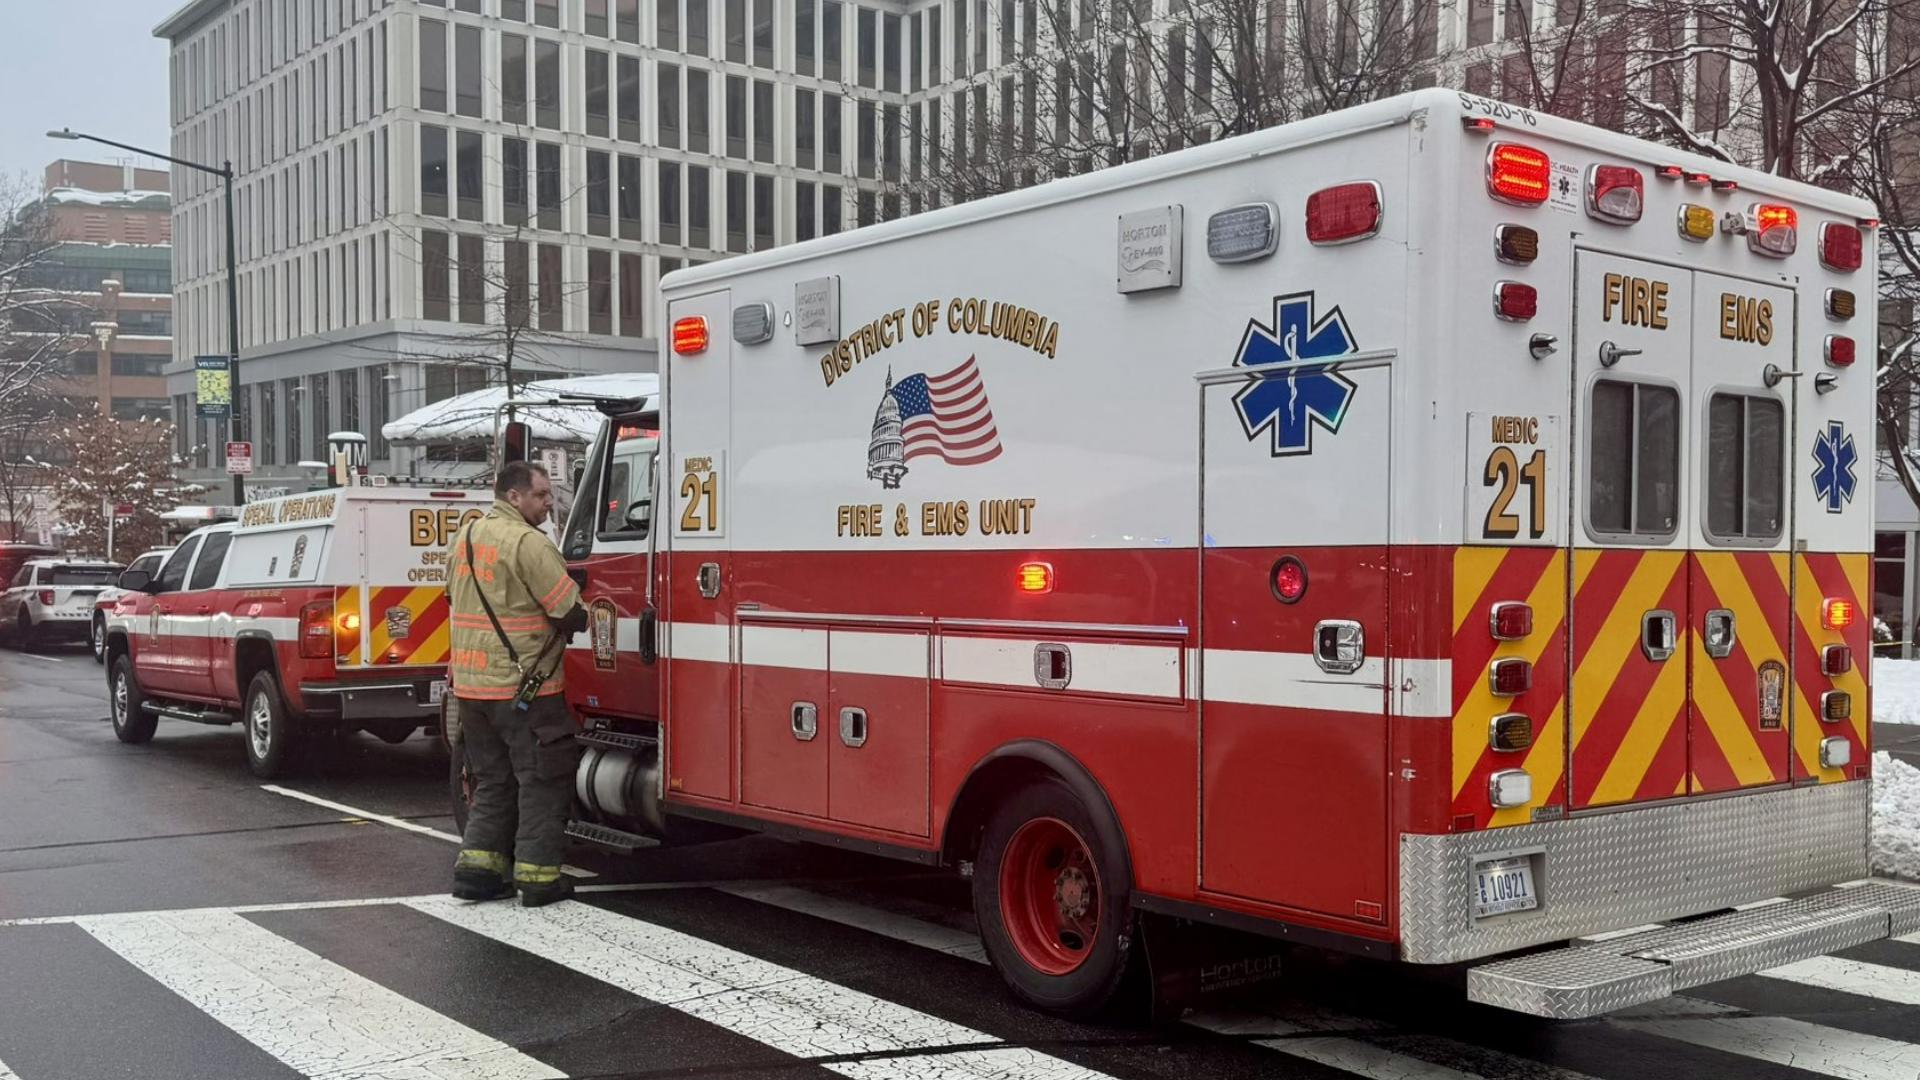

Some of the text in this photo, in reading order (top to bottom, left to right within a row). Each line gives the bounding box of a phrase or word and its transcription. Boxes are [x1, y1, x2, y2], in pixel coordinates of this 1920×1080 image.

[1459, 93, 1536, 126] S-520-16
[1122, 224, 1167, 243] HORTON
[1603, 272, 1773, 346] FIRE EMS
[820, 297, 1059, 387] DISTRICT OF COLUMBIA
[1492, 415, 1538, 444] MEDIC
[353, 442, 367, 466] M
[684, 456, 713, 473] MEDIC
[680, 471, 717, 531] 21
[1482, 445, 1545, 539] 21
[242, 494, 336, 527] SPECIAL OPERATIONS
[837, 498, 1035, 537] FIRE & EMS UNIT
[1490, 871, 1527, 902] 10921
